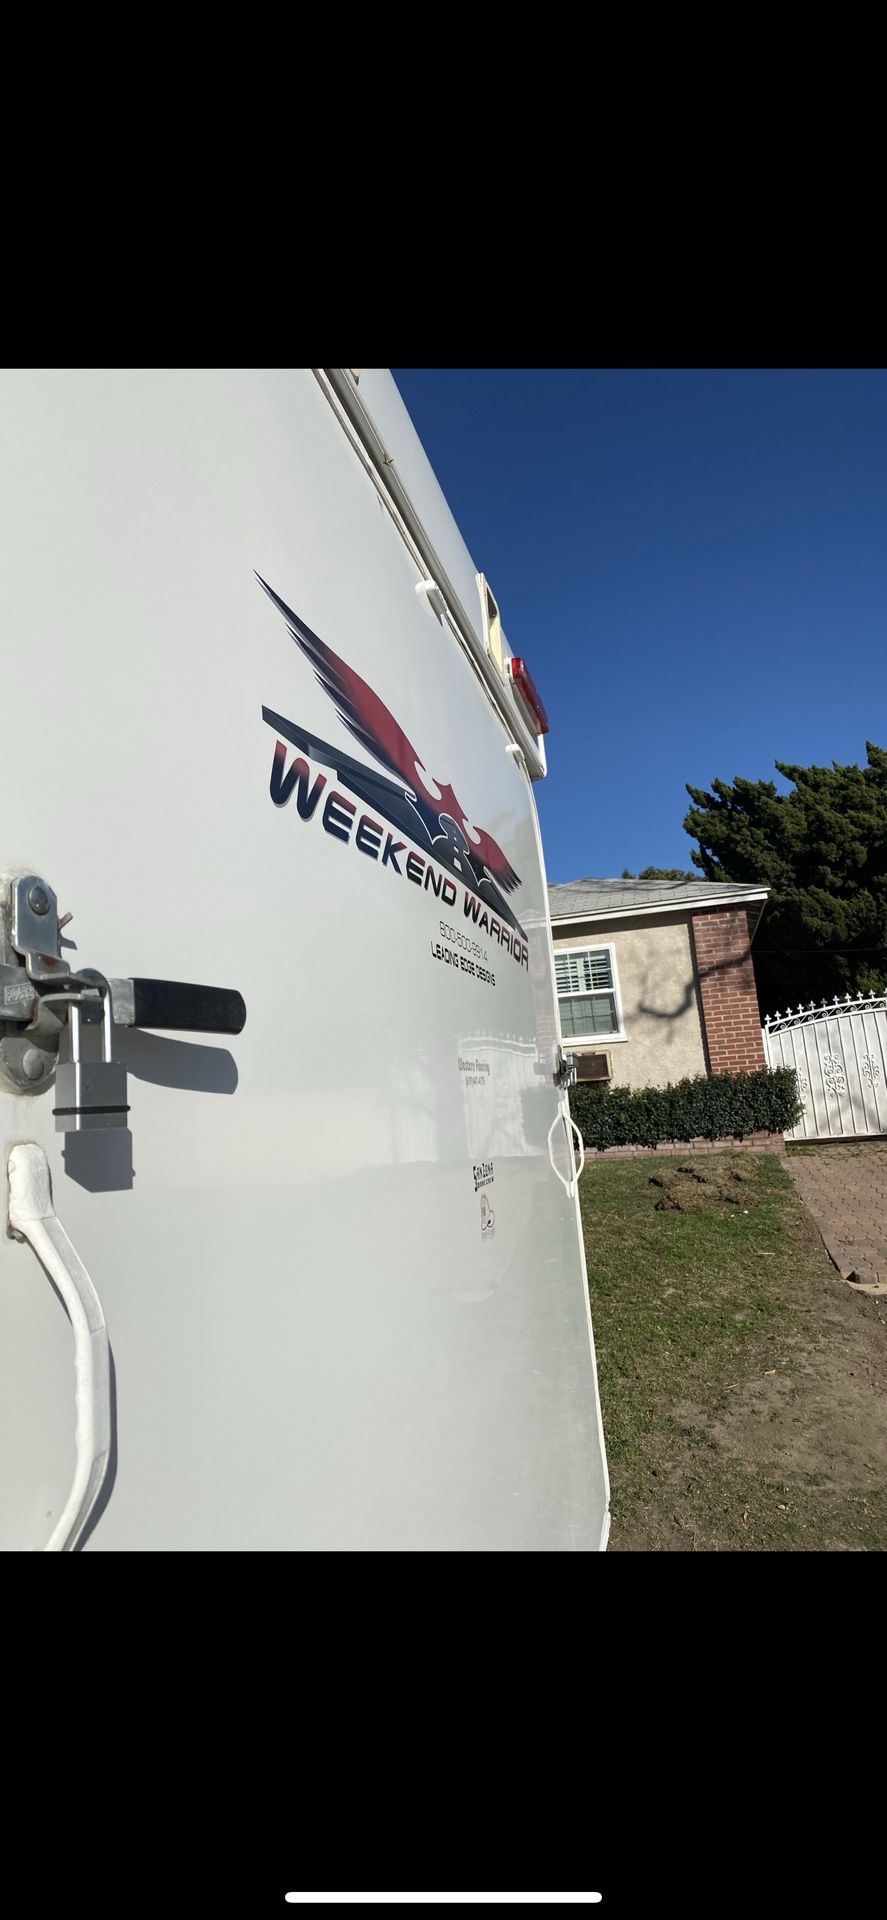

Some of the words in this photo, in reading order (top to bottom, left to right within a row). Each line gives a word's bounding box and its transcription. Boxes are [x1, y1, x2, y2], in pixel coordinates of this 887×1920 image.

[269, 739, 458, 907] WEEKEND
[463, 890, 529, 972] WARRIOR
[430, 940, 459, 968] LEADING
[460, 955, 476, 976] EDGE
